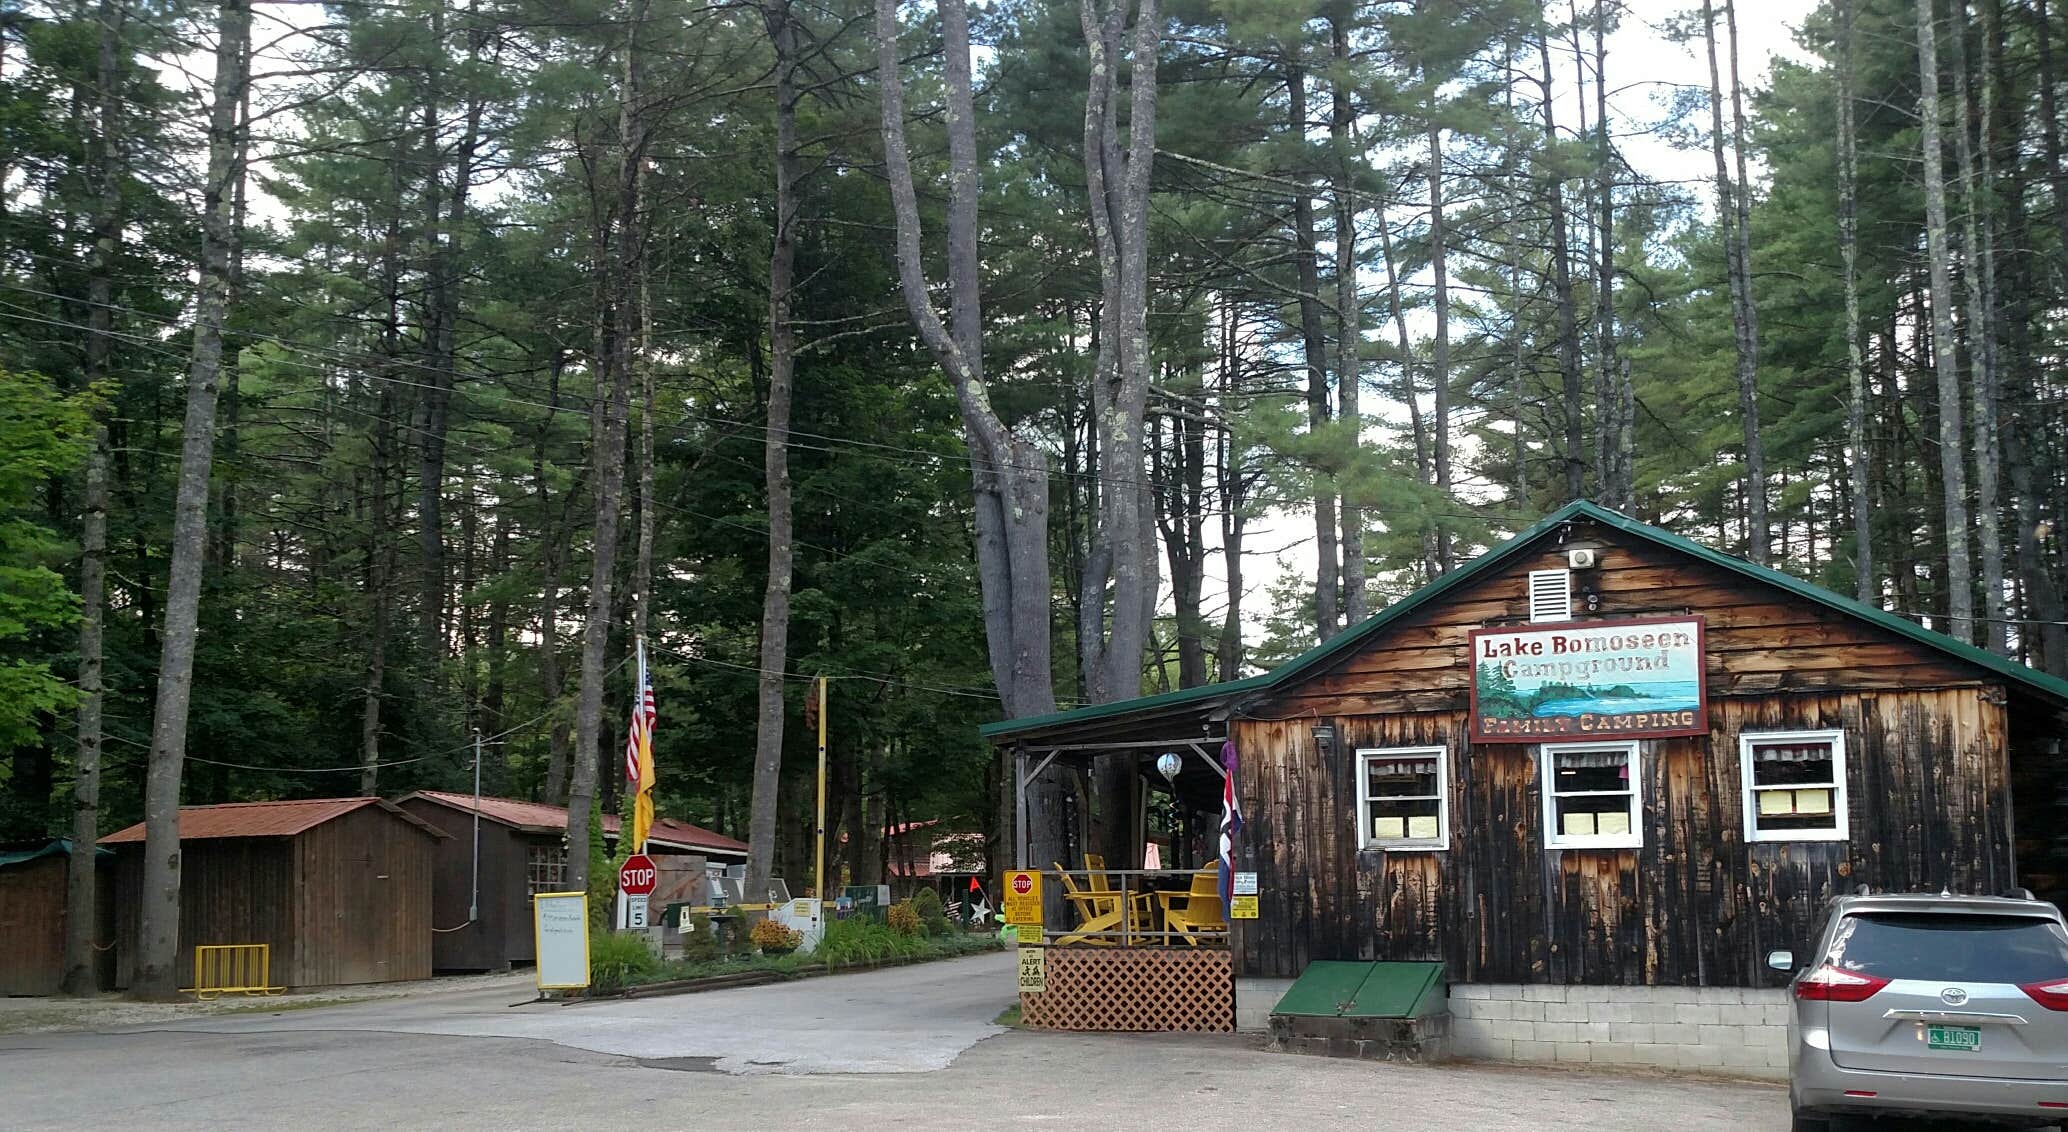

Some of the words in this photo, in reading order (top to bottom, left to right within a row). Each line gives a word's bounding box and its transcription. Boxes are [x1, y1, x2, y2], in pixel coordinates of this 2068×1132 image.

[1483, 638, 1543, 658] Lake
[1551, 631, 1690, 655] Bomoseen
[1502, 650, 1670, 680] Campground
[1580, 712, 1695, 732] CAMPING
[622, 869, 654, 887] STOP
[1013, 880, 1032, 889] STOP
[634, 913, 643, 925] 5
[1020, 976, 1043, 987] CHILDREN
